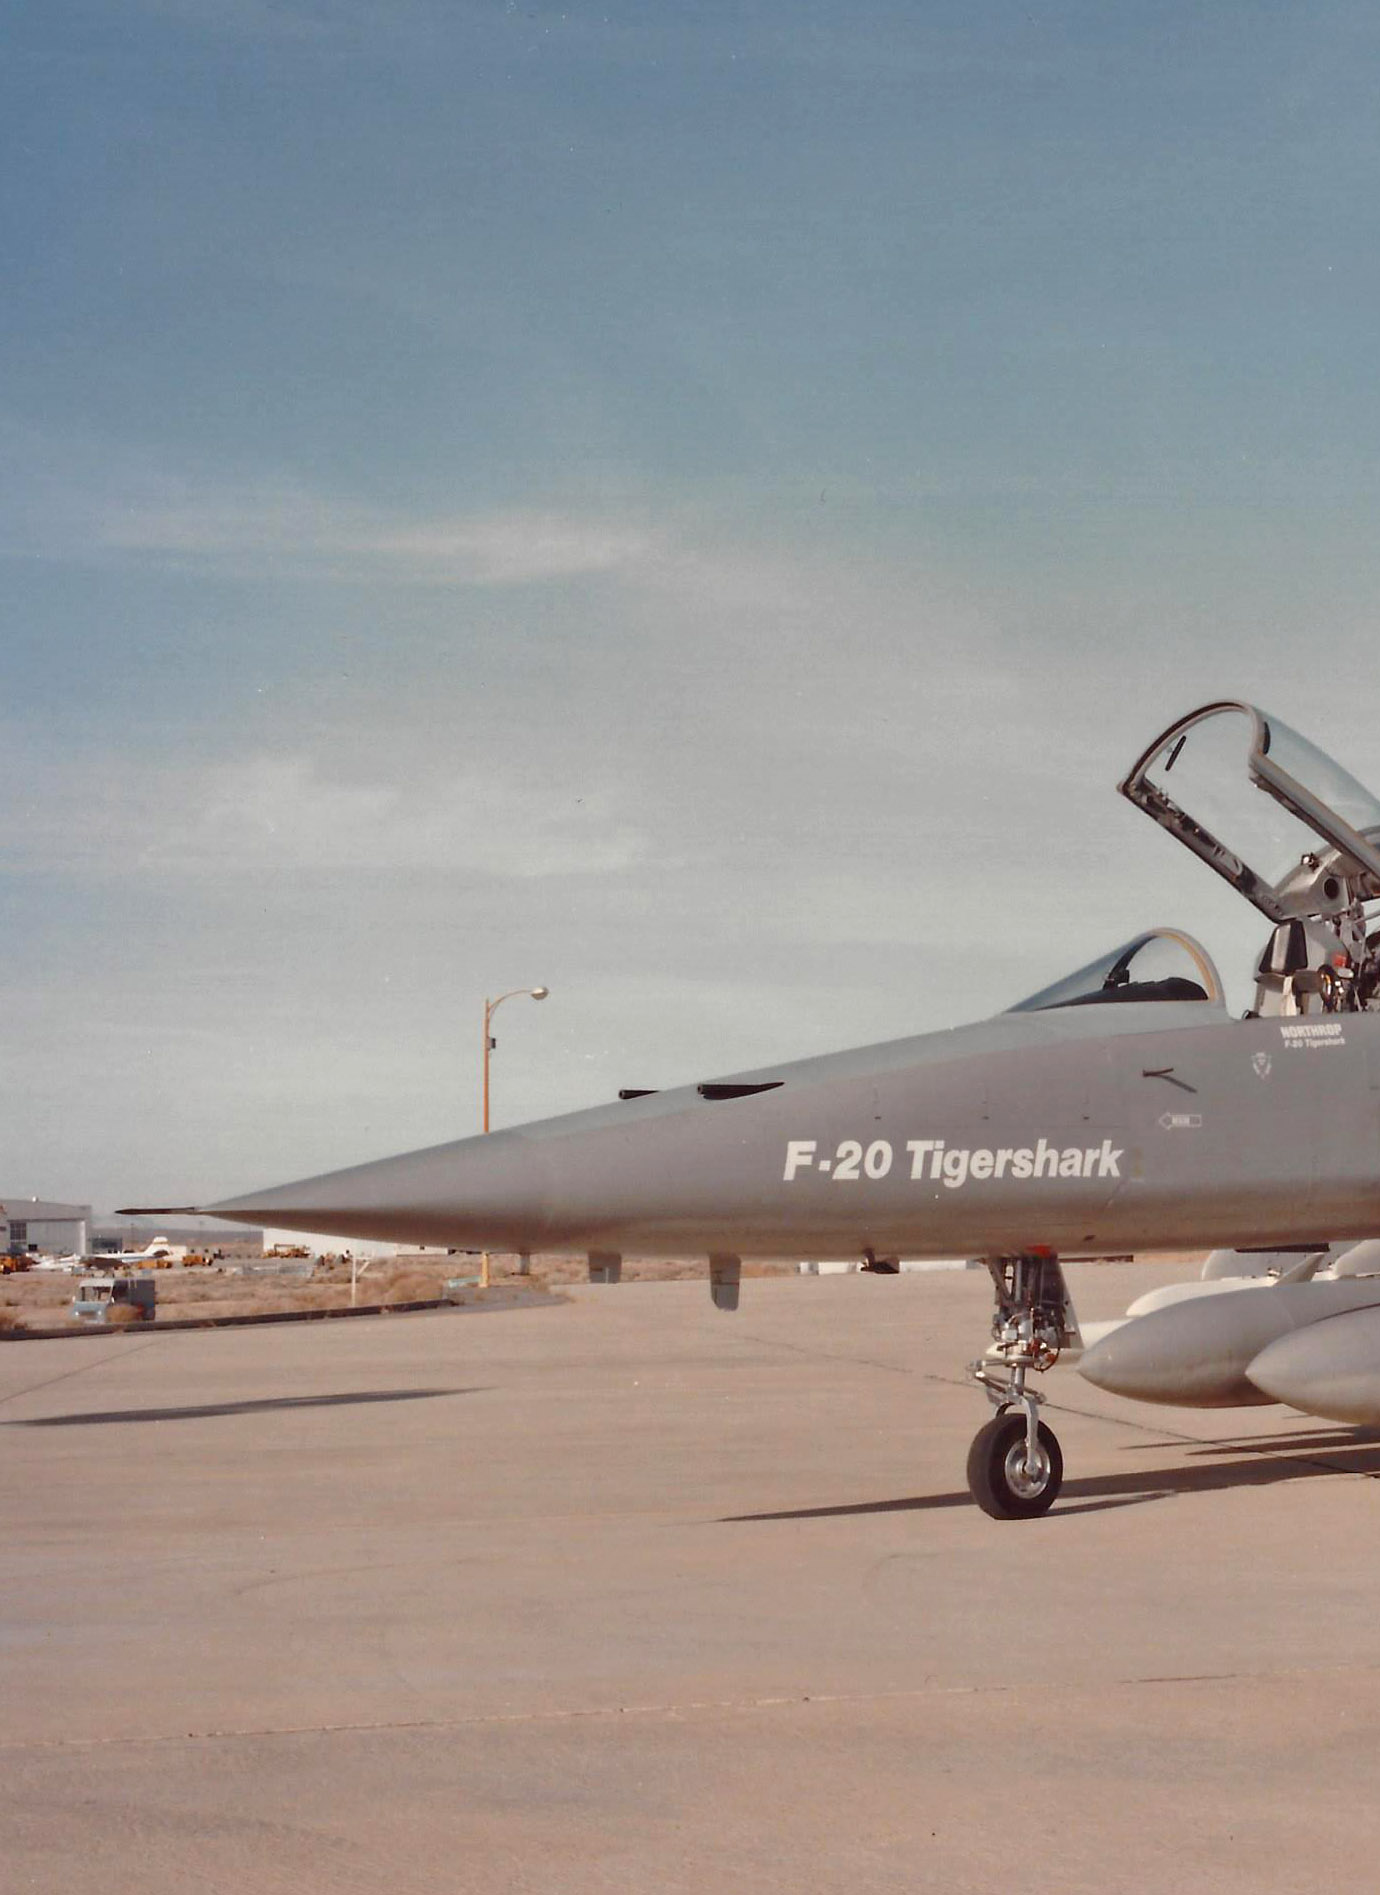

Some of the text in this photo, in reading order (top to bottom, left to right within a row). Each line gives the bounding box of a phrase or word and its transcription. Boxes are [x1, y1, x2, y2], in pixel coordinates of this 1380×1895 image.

[1280, 1024, 1342, 1038] NORTHROP
[783, 1138, 1124, 1188] F-20 Tigershark
